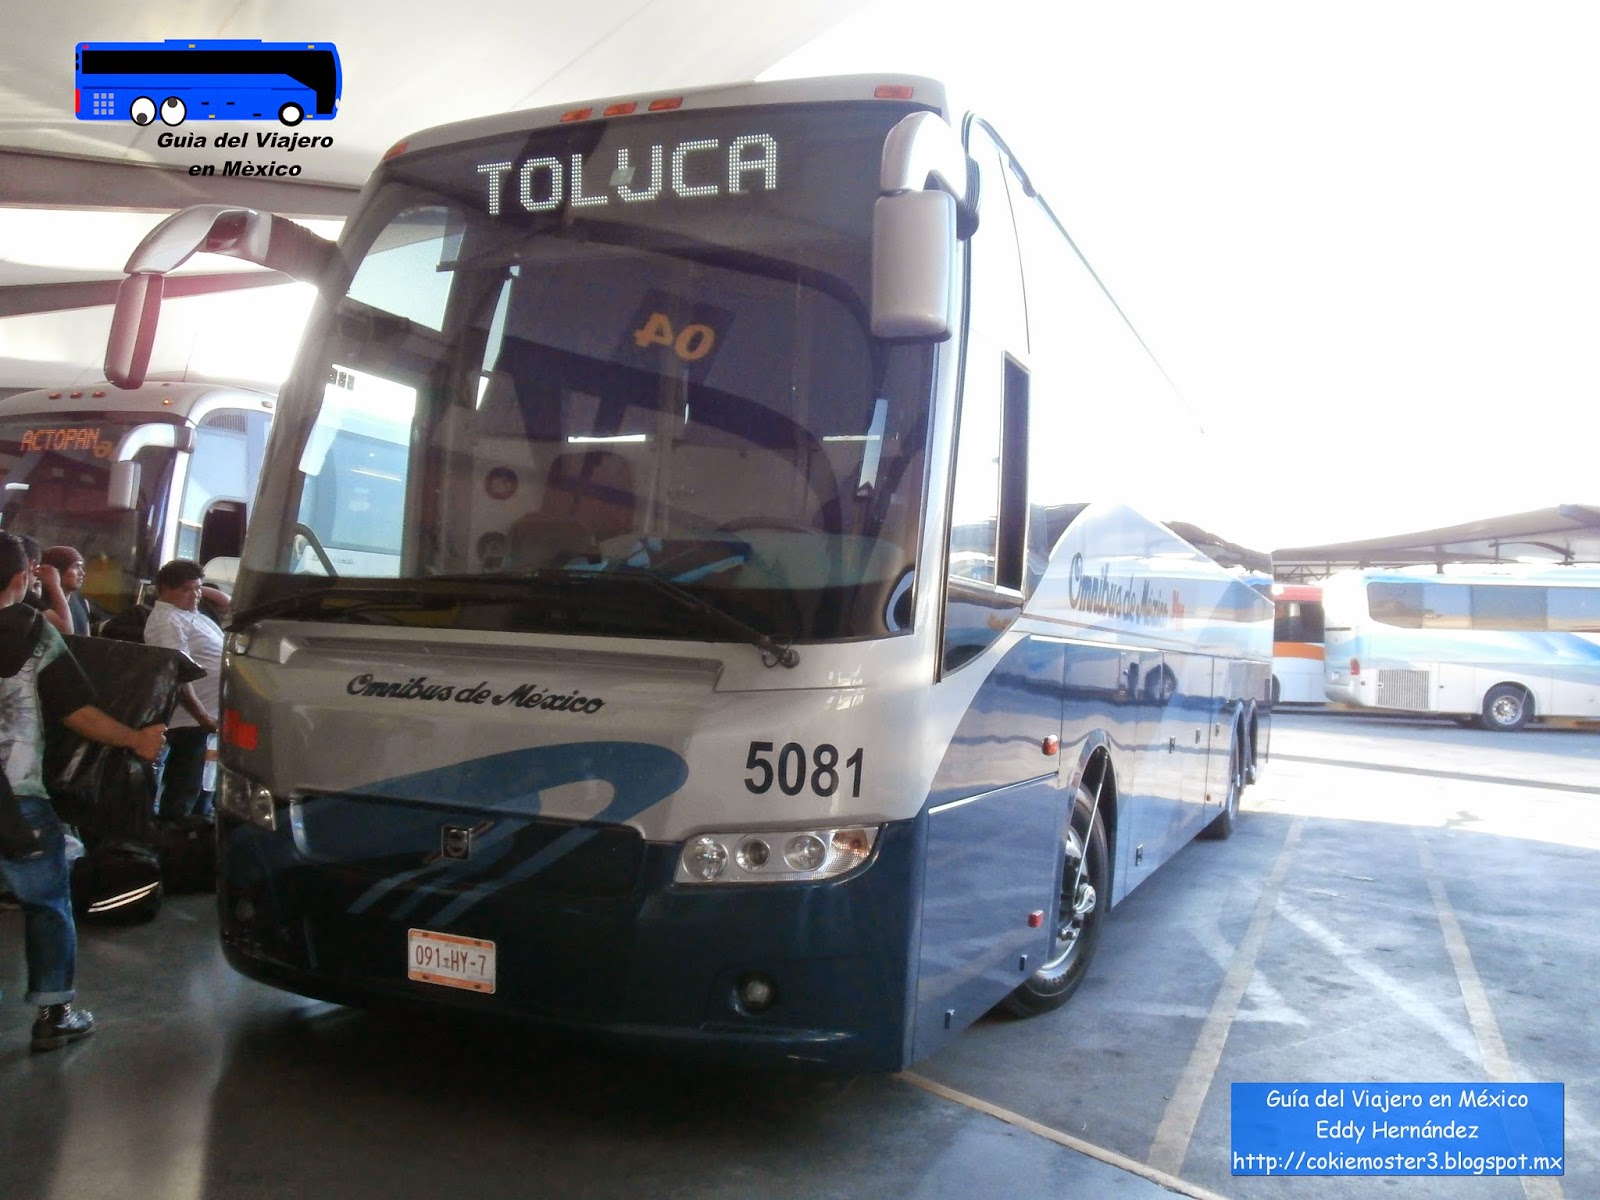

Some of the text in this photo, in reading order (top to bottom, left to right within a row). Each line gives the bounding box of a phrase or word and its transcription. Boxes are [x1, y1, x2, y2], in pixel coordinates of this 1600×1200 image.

[477, 133, 777, 215] TOLUCA
[20, 428, 100, 451] ACTOPAN
[347, 673, 606, 714] Omnibus de México
[743, 740, 864, 798] 5081
